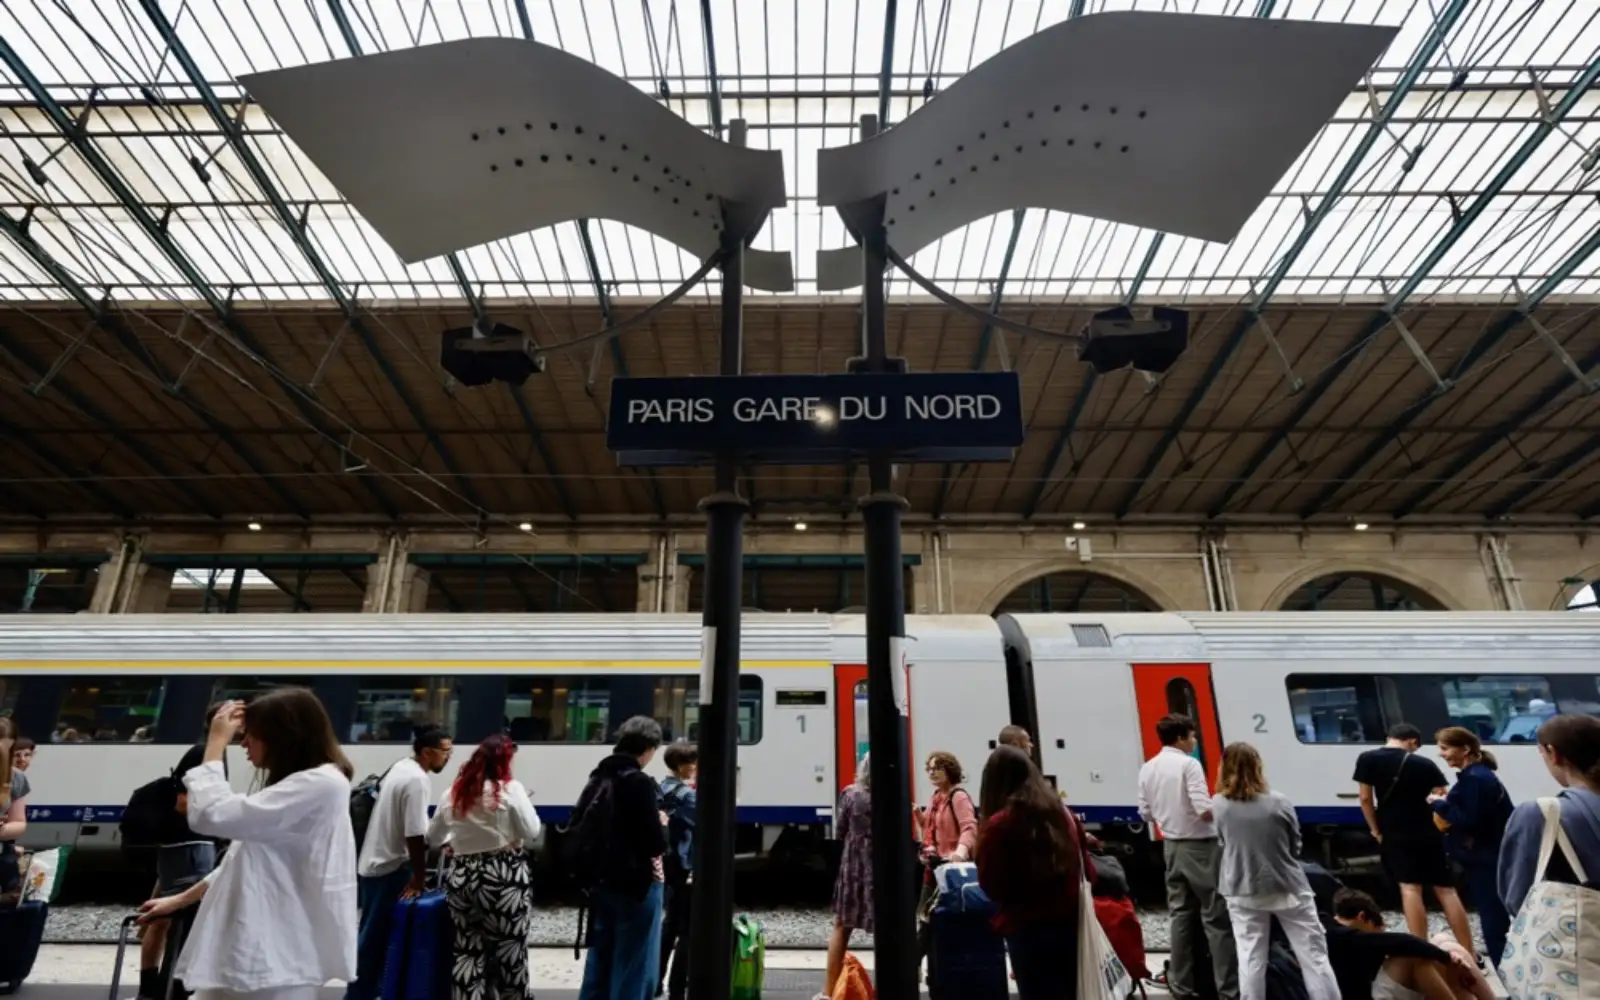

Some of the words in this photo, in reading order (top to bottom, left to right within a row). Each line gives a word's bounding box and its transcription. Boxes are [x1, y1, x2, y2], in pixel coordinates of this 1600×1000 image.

[627, 398, 714, 423] PARIS
[733, 397, 820, 422] GARE
[839, 396, 887, 420] DU
[905, 394, 1001, 419] NORD
[796, 714, 806, 734] 1
[1252, 713, 1268, 734] 2
